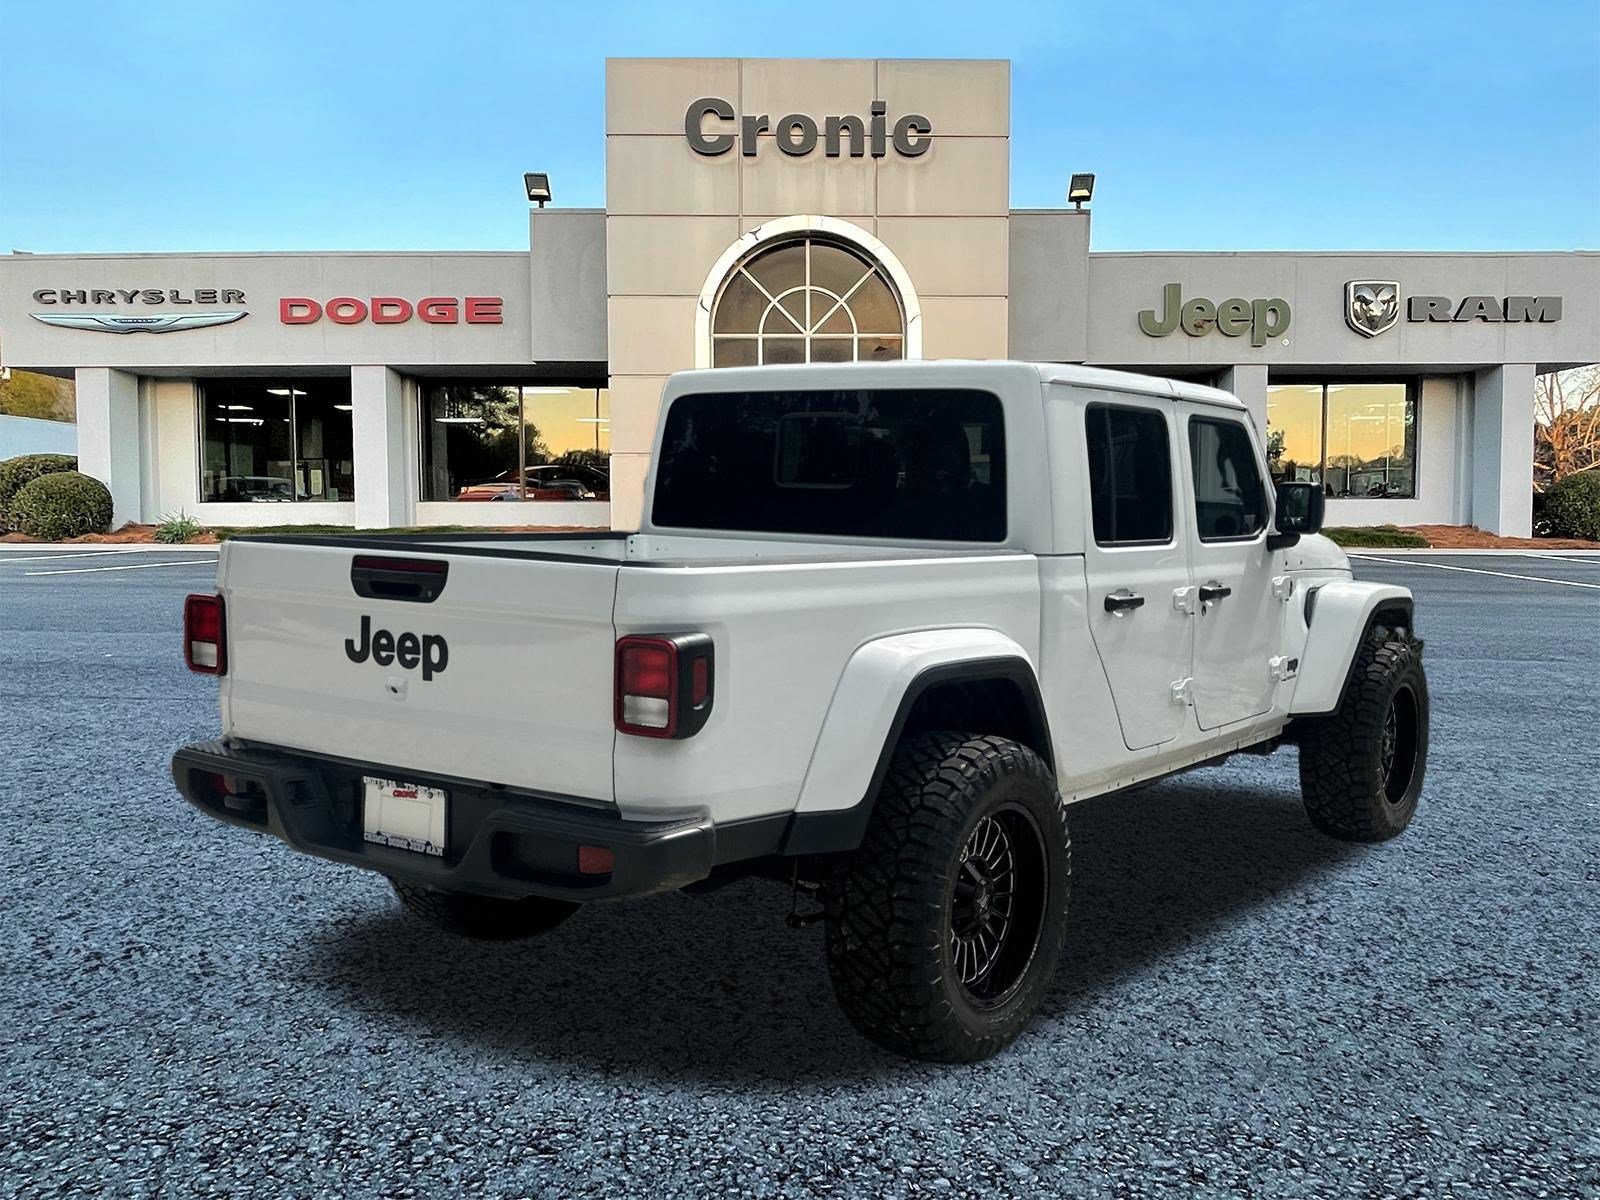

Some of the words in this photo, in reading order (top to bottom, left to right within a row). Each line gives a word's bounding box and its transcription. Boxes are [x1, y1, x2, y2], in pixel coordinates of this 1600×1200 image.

[685, 97, 932, 157] Cronic
[33, 289, 246, 304] CHRYSLER
[280, 297, 503, 324] DODGE
[1138, 283, 1291, 347] Jeep
[1407, 296, 1563, 322] RAM
[345, 615, 448, 681] Jeep
